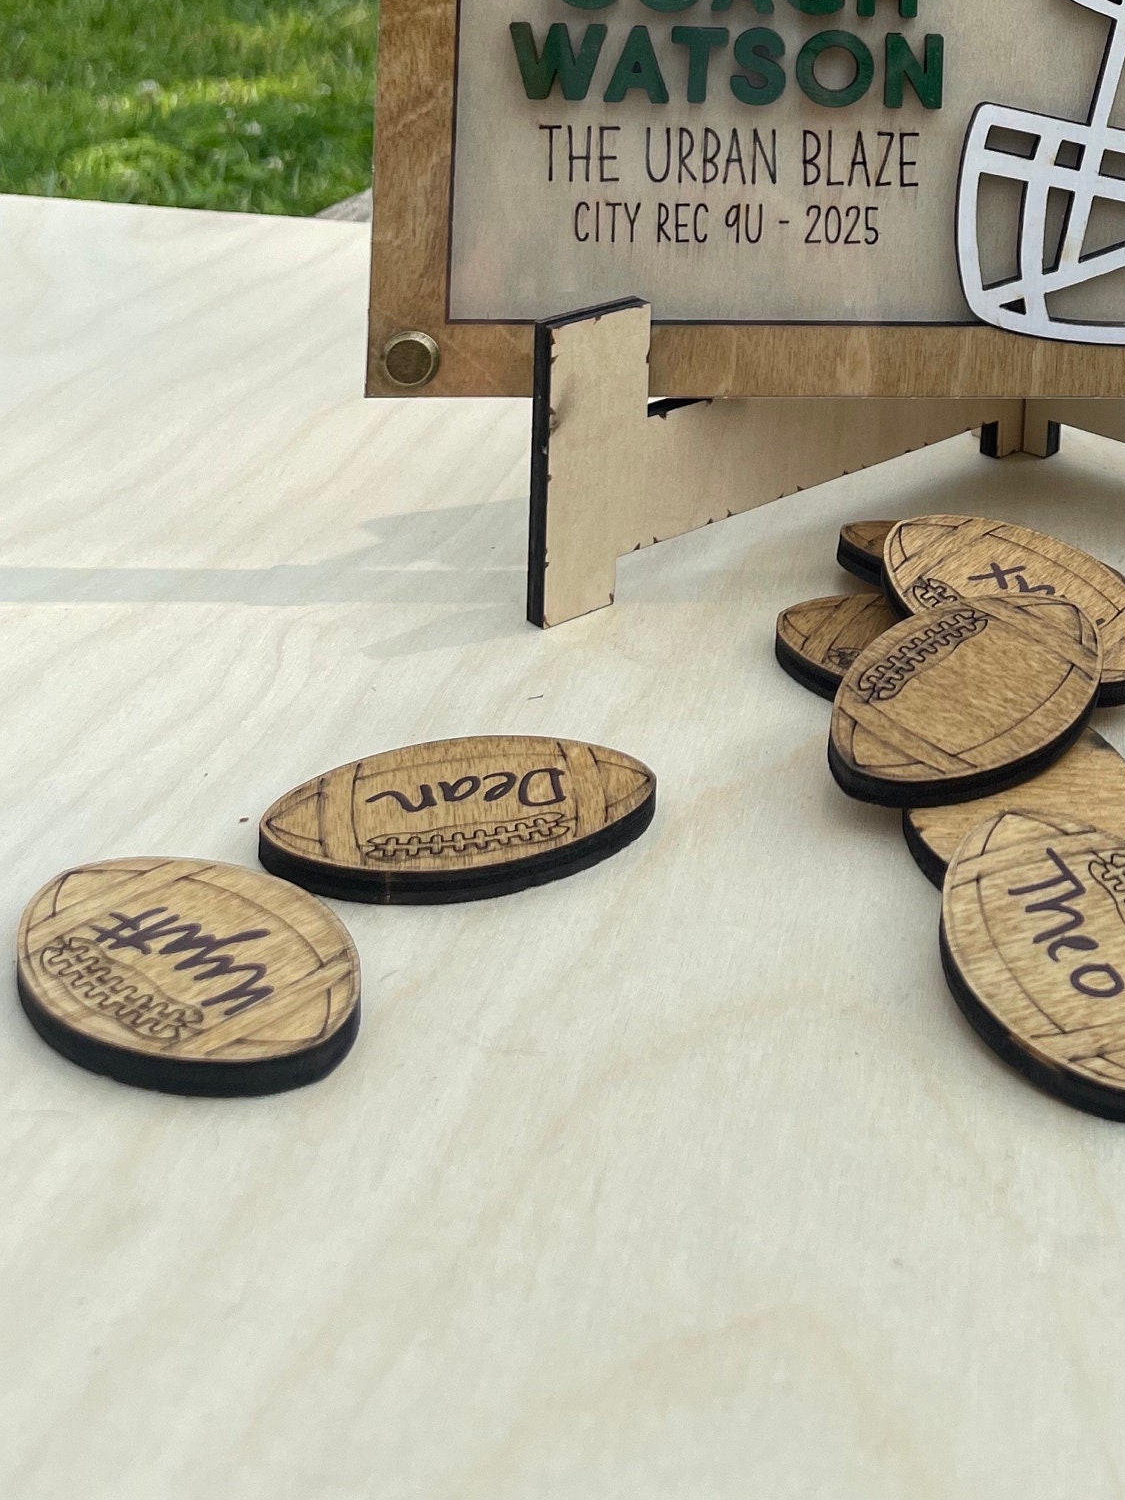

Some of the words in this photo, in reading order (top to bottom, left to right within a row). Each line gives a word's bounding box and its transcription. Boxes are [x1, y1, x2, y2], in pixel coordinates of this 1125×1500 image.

[509, 21, 945, 110] WATSON
[539, 124, 621, 184] THE
[645, 126, 778, 185] URBAN
[802, 129, 920, 187] BLAZE
[574, 201, 641, 243] CITY
[656, 203, 709, 243] REC
[725, 204, 764, 245] 9U
[804, 206, 880, 245] 2025
[365, 767, 567, 812] Dean
[1008, 846, 1125, 998] Theo
[89, 906, 275, 1016] Wyatt
